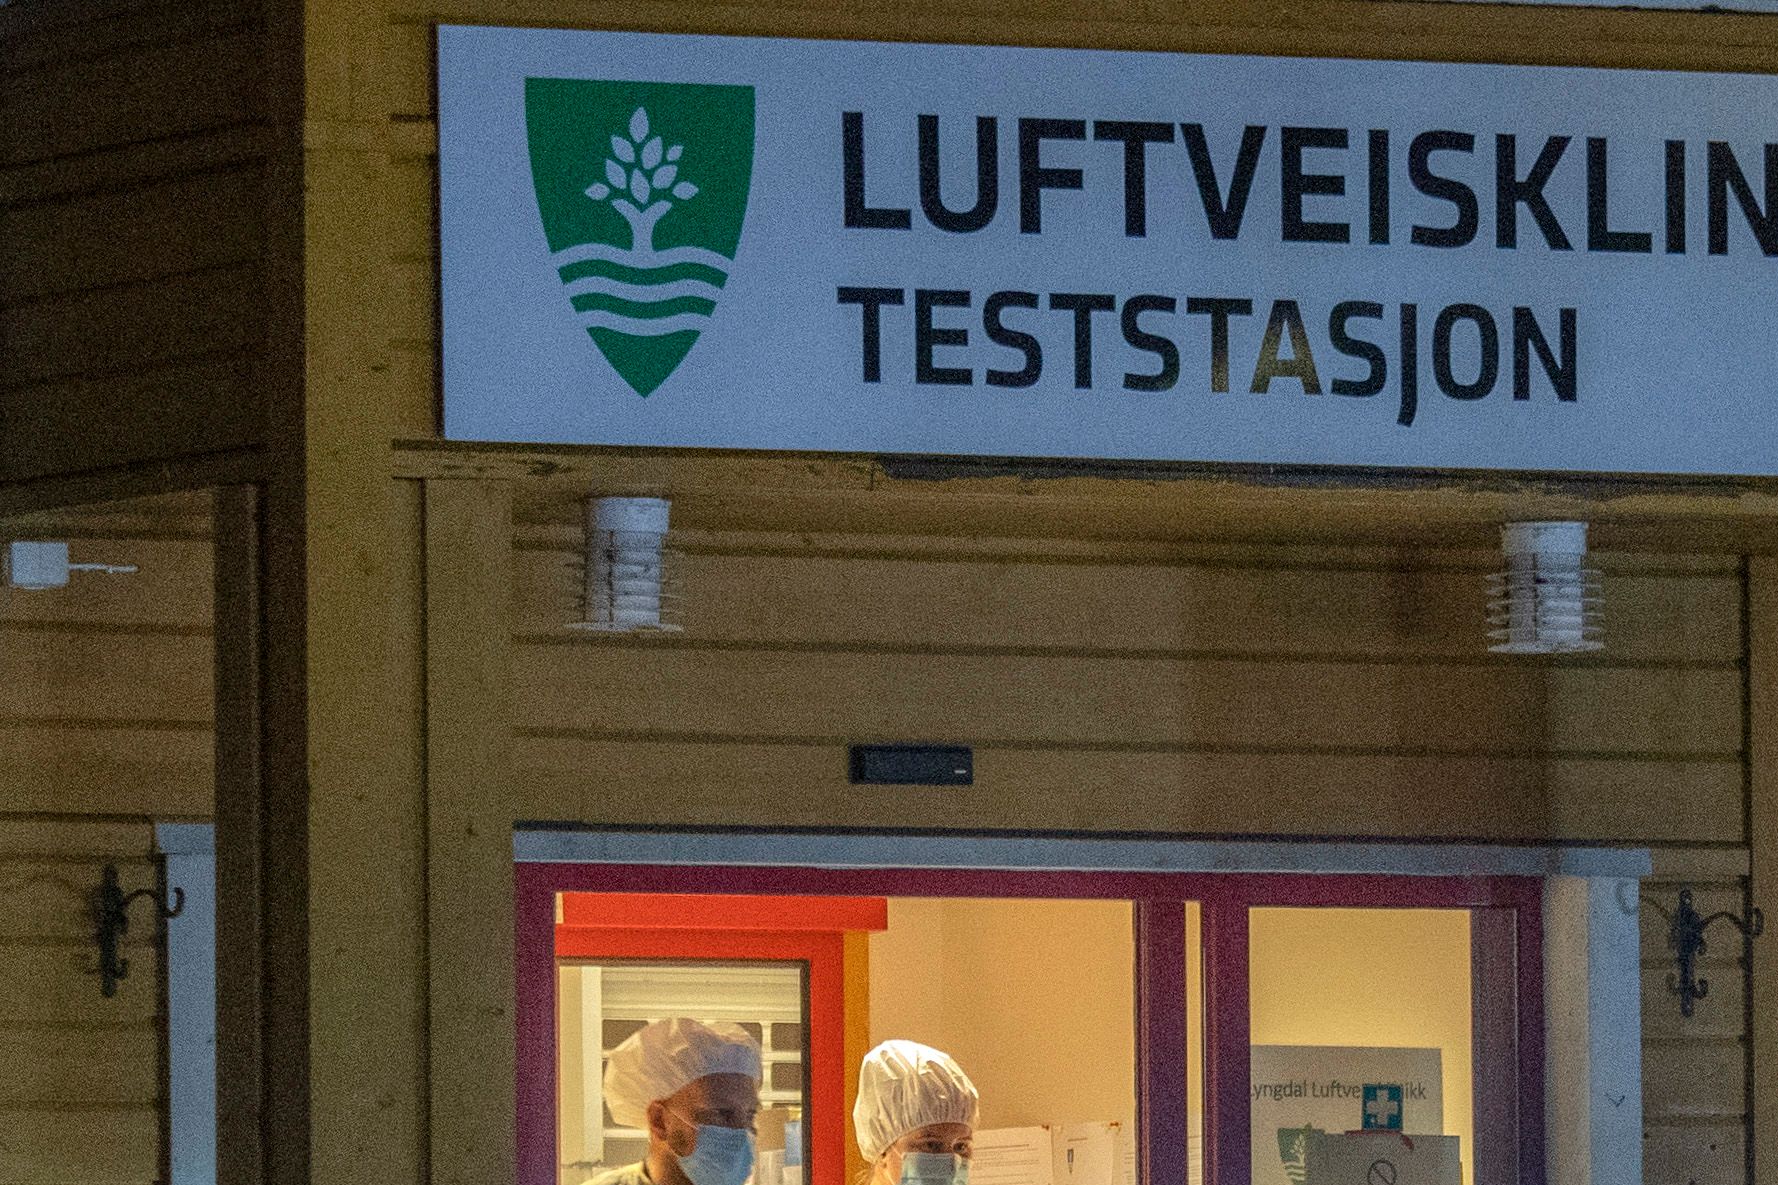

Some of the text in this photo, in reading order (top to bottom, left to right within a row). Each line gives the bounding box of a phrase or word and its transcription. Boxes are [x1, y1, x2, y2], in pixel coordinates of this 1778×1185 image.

[837, 285, 1578, 427] TESTSTASJON
[1250, 1079, 1427, 1101] yngdal Luftveikk
